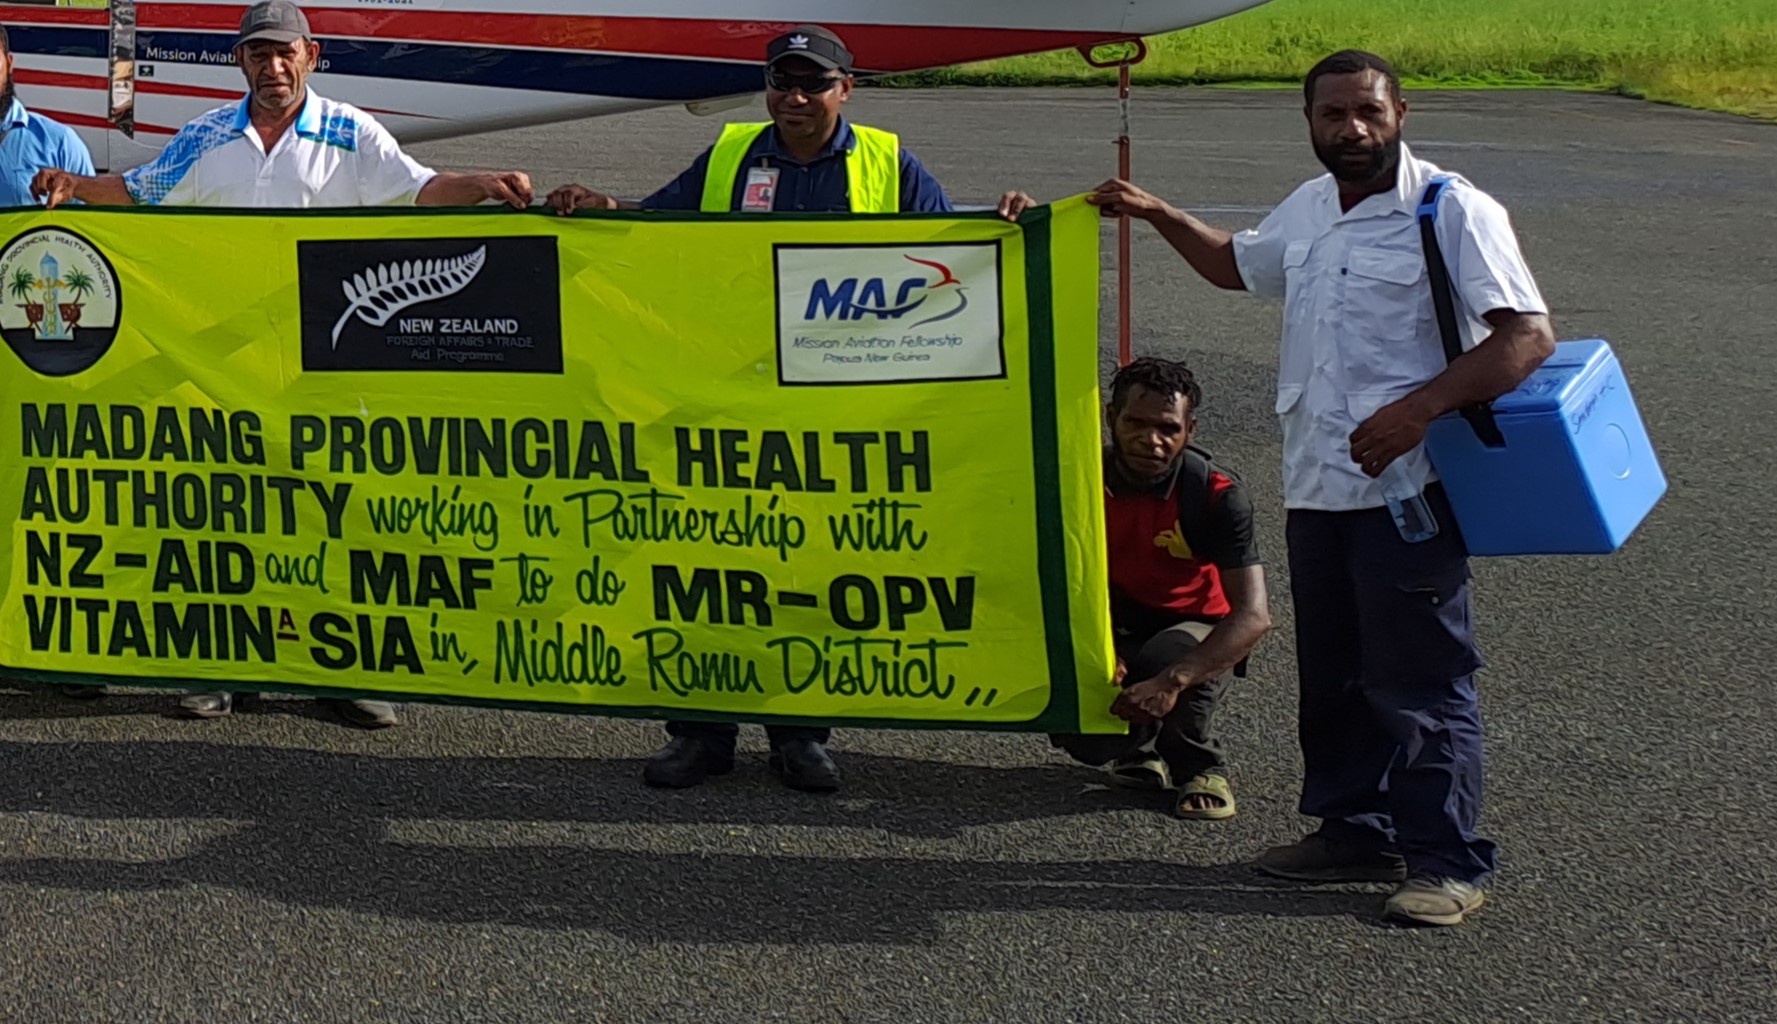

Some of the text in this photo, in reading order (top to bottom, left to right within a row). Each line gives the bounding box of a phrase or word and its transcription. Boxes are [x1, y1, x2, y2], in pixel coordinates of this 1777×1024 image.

[145, 46, 236, 65] Mission Aviati
[55, 236, 86, 253] HEALTH
[86, 253, 112, 299] AUTHORITY
[804, 278, 928, 321] MAF
[386, 335, 435, 346] FOREIGN
[439, 336, 485, 347] AFFAIRS
[495, 336, 535, 348] TRADE
[399, 318, 519, 335] NEW ZEALAND
[791, 334, 963, 349] Mission Aviation Fellowship
[410, 348, 505, 363] Aid Programme
[823, 352, 931, 365] Papua New Guinea
[21, 402, 932, 493] MADANG PROVINCIAL HEALTH
[20, 467, 928, 561] AUTHORITY working in Partnership with
[24, 530, 976, 632] NZ-AID and MAF to do MR-OPV
[308, 613, 425, 675] SIA
[494, 619, 627, 686] Middle
[631, 627, 765, 696] Ramu
